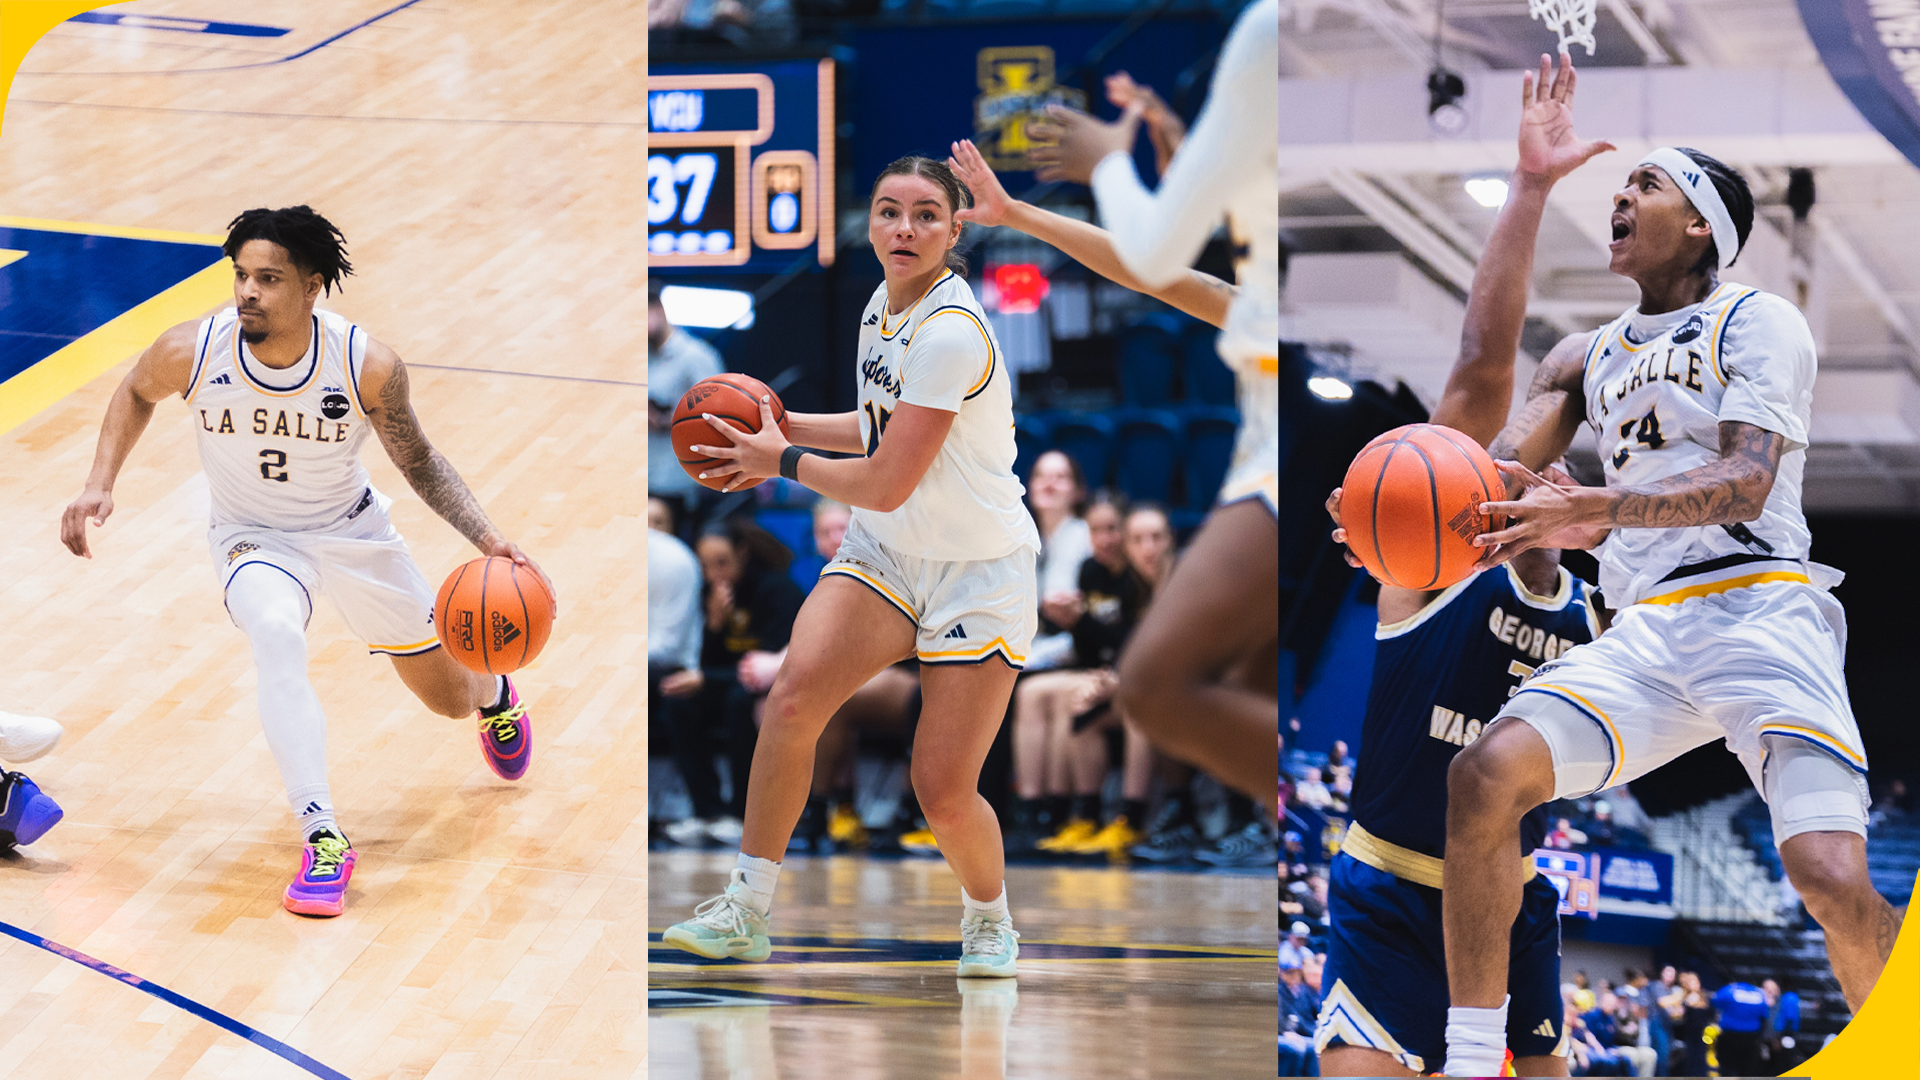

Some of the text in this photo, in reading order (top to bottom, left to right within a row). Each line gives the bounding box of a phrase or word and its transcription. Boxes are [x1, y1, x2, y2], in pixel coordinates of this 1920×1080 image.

[648, 153, 718, 225] 37
[200, 408, 350, 443] LA SALLE
[258, 449, 289, 482] 2
[462, 610, 475, 652] PRO
[491, 611, 504, 652] adidas
[1429, 704, 1488, 747] WAS
